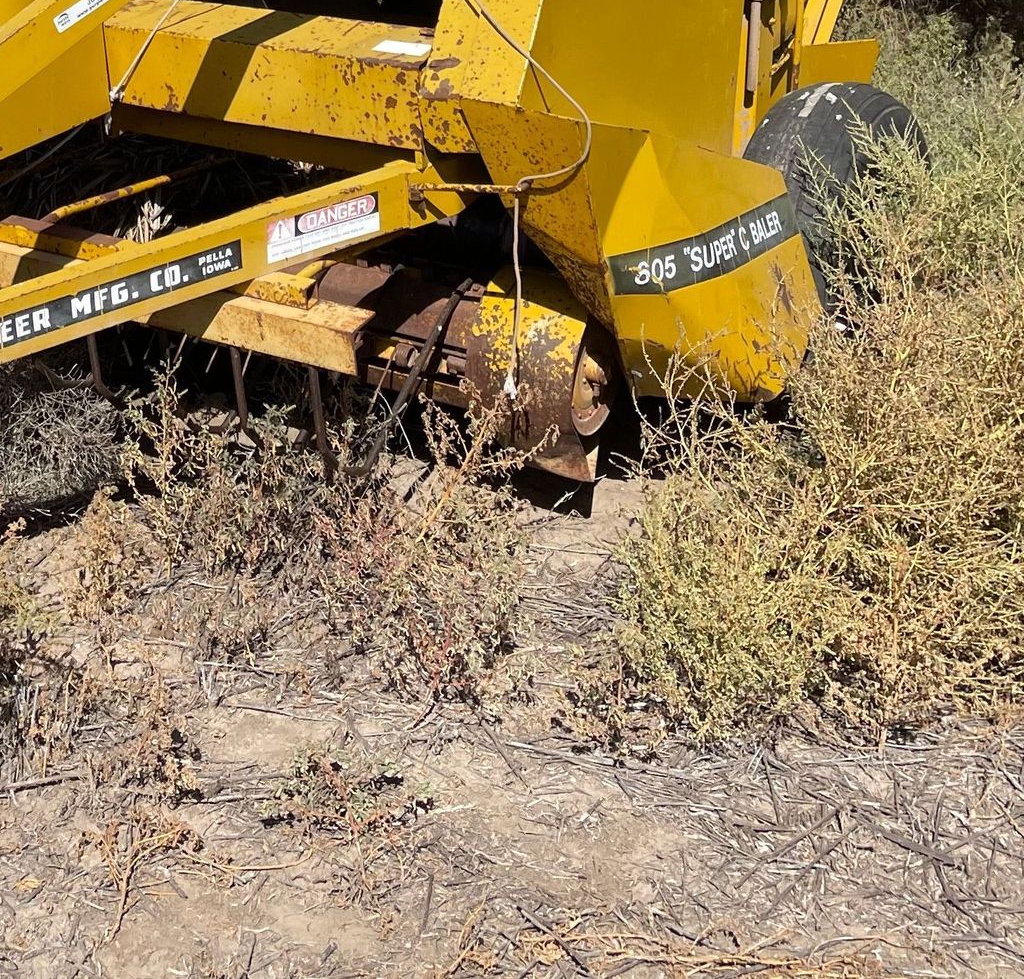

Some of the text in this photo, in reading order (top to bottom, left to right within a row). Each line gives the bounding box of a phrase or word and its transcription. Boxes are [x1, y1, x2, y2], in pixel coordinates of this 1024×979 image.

[305, 198, 368, 231] DANGER
[738, 226, 750, 251] C
[749, 211, 783, 245] BALER
[198, 248, 233, 266] PELLA
[202, 259, 232, 276] IOWA
[71, 282, 139, 319] MFG.
[149, 264, 189, 292] CO.
